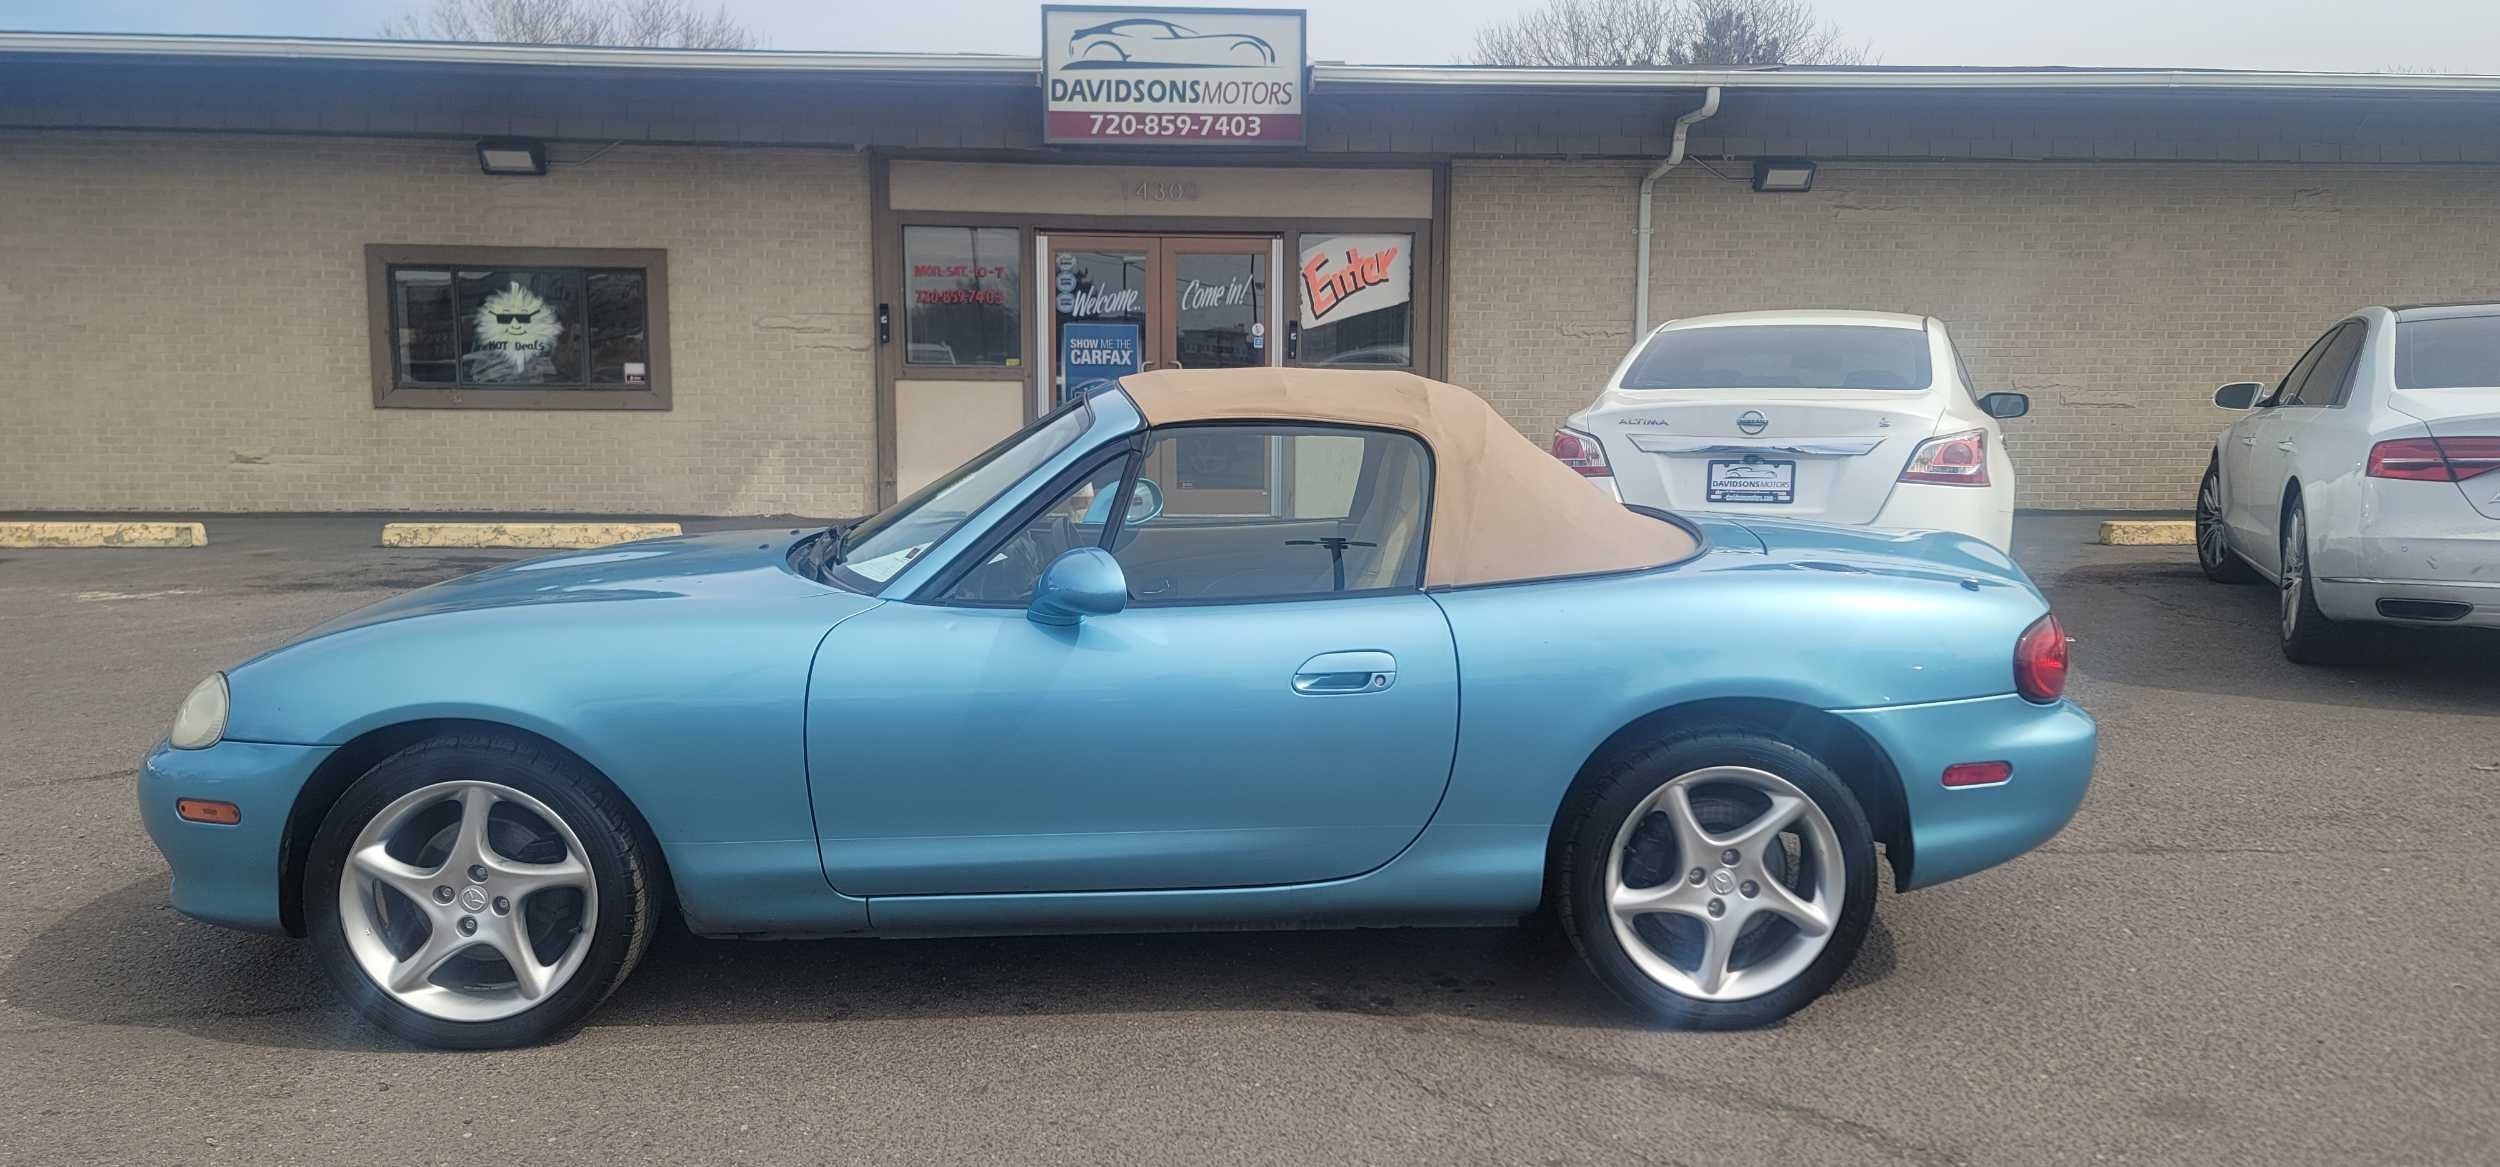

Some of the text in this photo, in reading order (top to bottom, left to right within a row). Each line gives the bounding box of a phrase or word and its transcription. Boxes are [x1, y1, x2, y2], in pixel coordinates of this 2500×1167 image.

[1050, 78, 1293, 105] DAVIDSONSMOTORS
[1089, 114, 1262, 137] 720-859-7403
[1182, 276, 1253, 310] Come in!
[1302, 247, 1398, 319] Enter
[488, 340, 545, 351] HOT Deals
[1070, 338, 1132, 349] SHOW ME THE
[1071, 349, 1132, 366] CARFAX
[1618, 417, 1669, 427] ALTIMA
